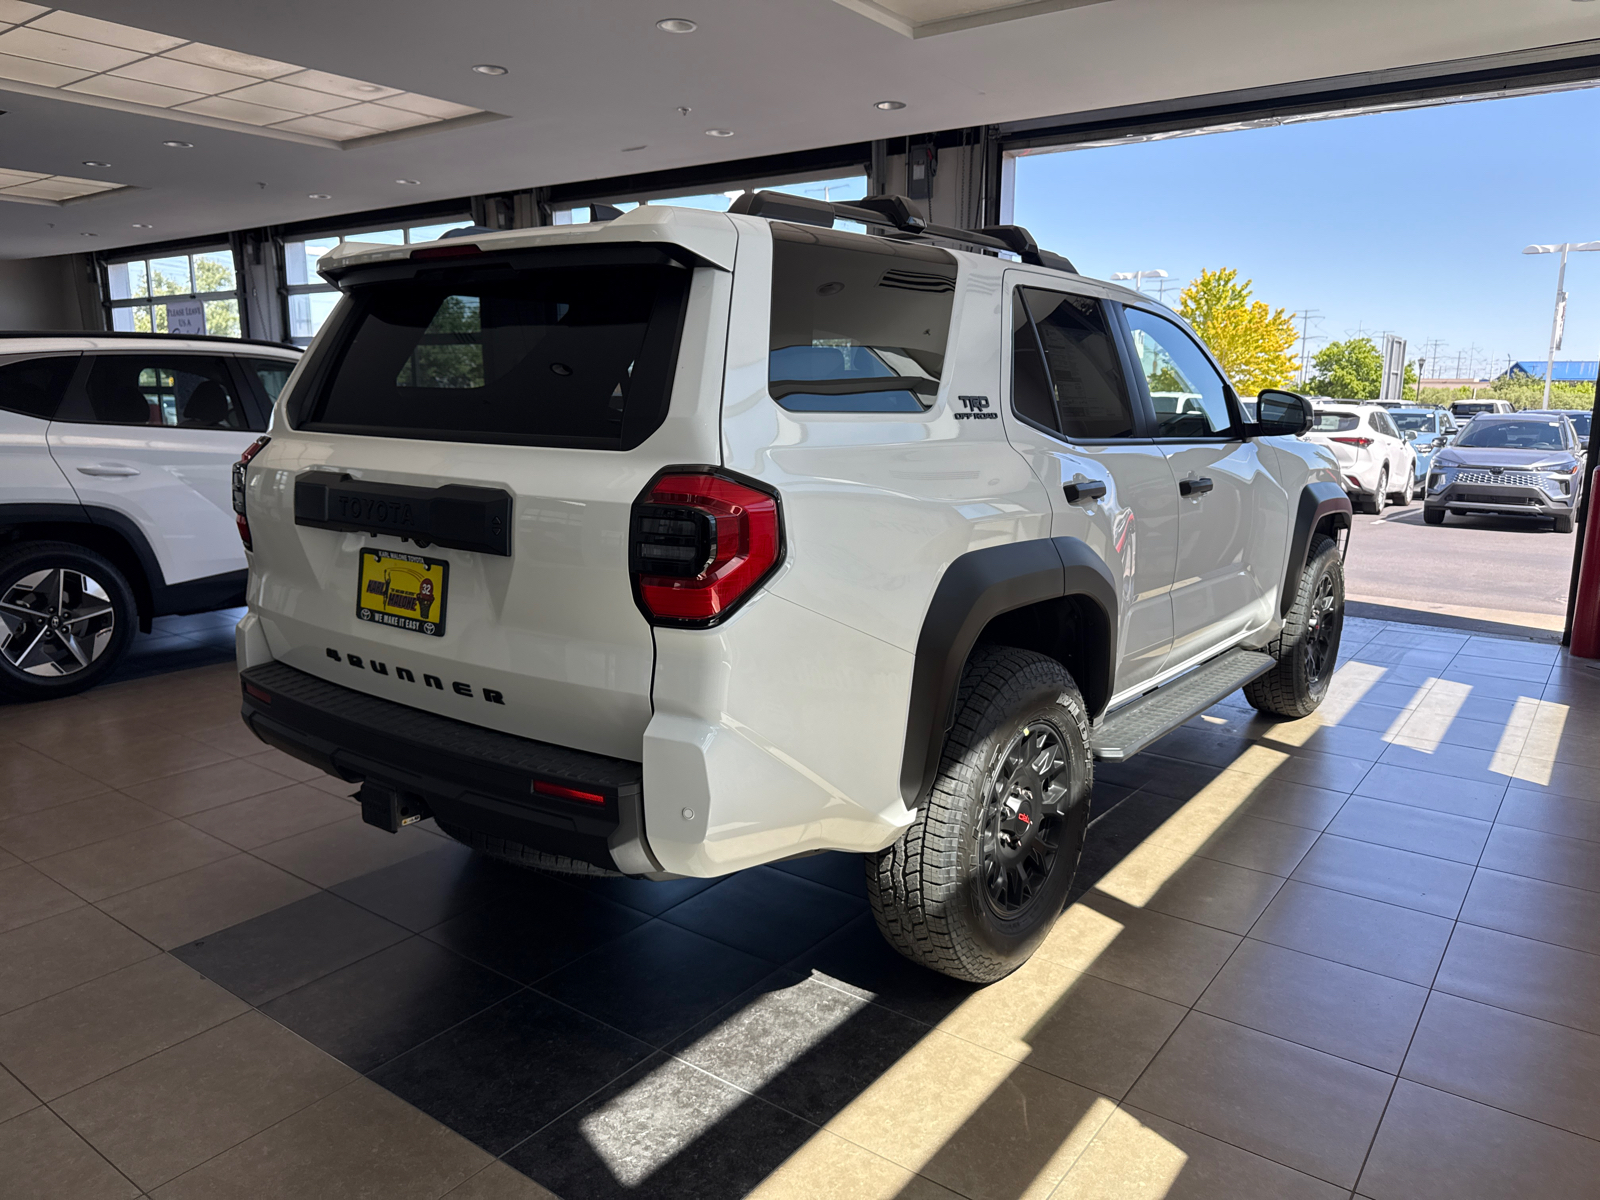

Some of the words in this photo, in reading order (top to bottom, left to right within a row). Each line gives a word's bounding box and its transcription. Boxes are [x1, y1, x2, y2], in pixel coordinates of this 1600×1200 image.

[167, 309, 184, 317] PLEASE
[186, 307, 201, 316] LEAVE
[958, 396, 990, 412] TRD
[339, 496, 415, 526] TOYOTA
[422, 584, 431, 595] 32
[388, 594, 416, 611] MALONE
[374, 613, 382, 622] WE
[383, 615, 398, 625] MAKE
[399, 618, 405, 627] IT
[406, 620, 419, 630] EASY
[326, 648, 506, 706] 4RUNNER
